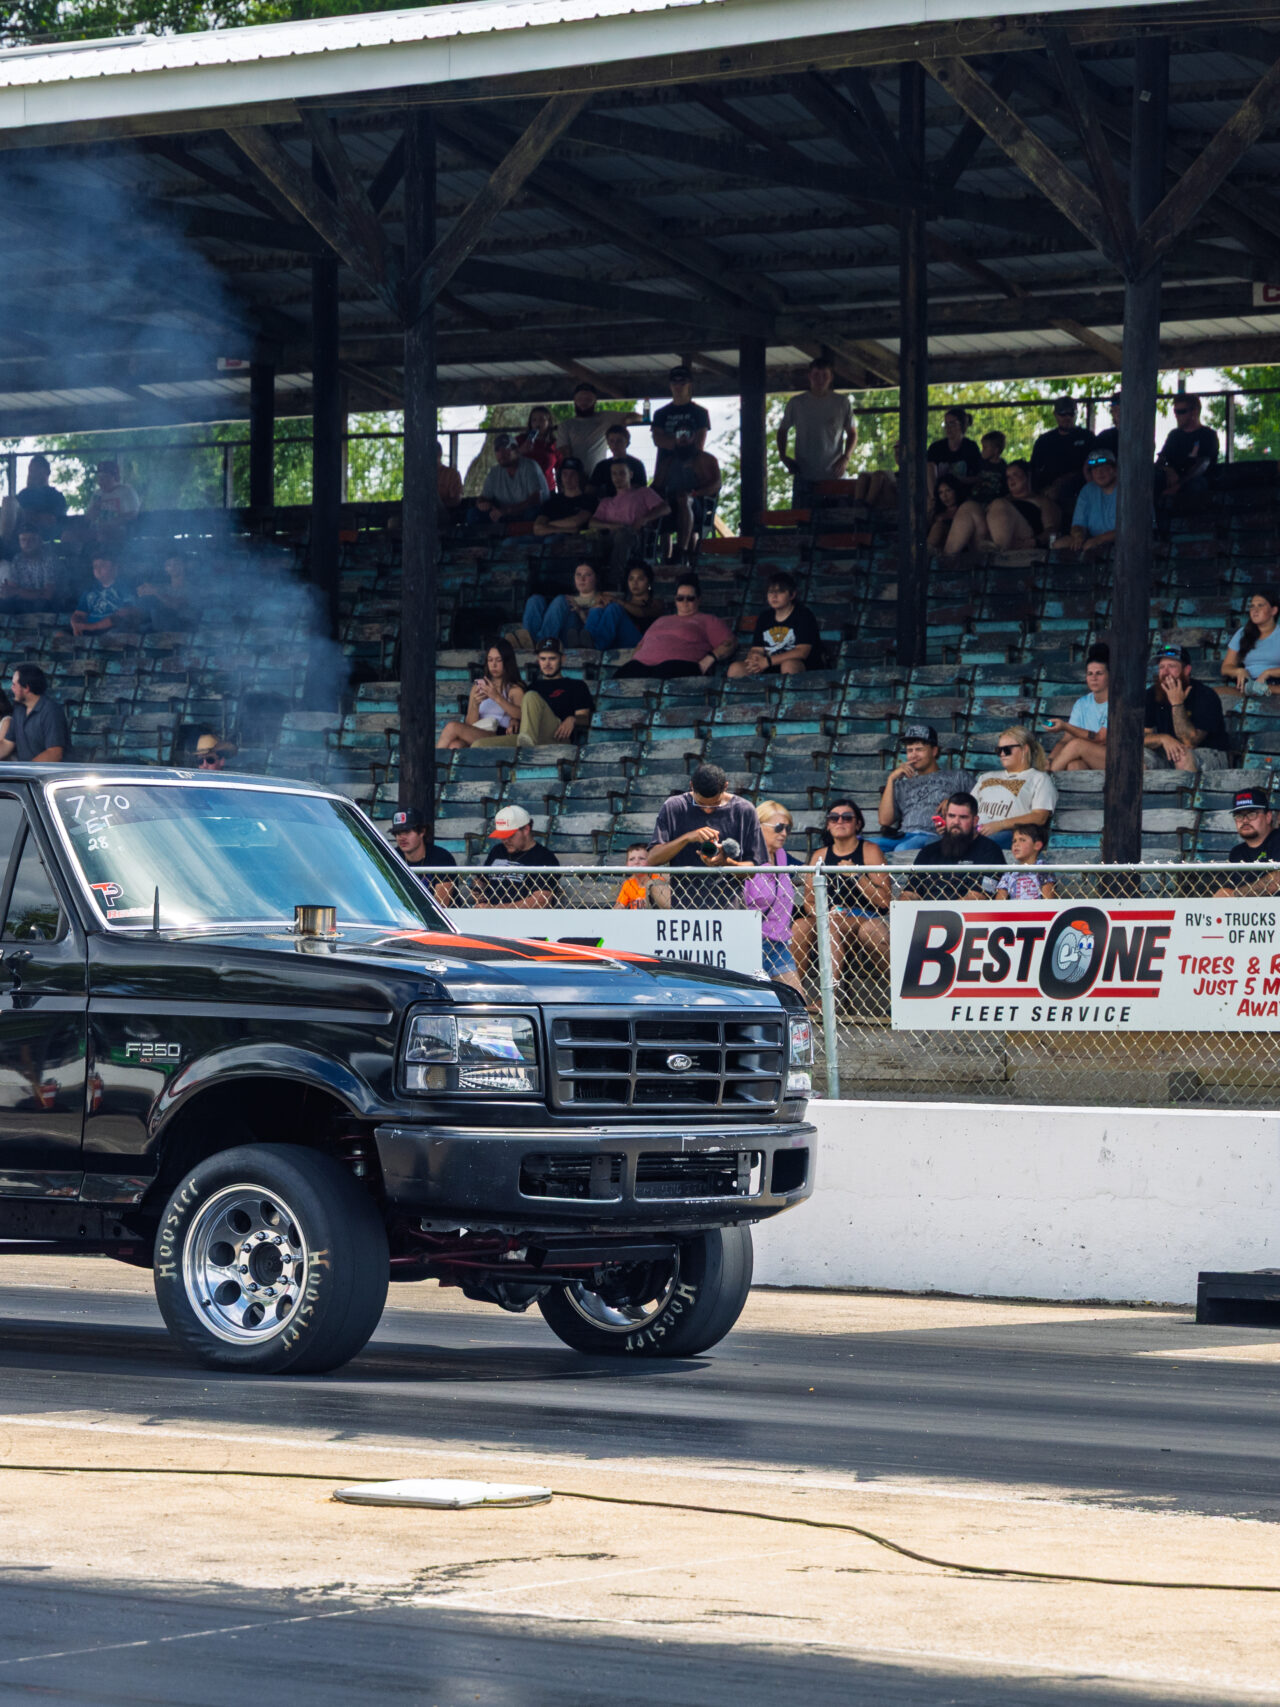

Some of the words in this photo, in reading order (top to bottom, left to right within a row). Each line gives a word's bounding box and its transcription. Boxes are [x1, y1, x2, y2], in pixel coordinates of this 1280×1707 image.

[66, 794, 130, 818] 7.70
[979, 797, 1013, 819] owgirl
[85, 813, 113, 834] ET
[87, 836, 109, 851] 28
[1185, 913, 1212, 926] RV's
[1225, 912, 1276, 926] TRUCKS
[656, 919, 723, 942] REPAIR
[1229, 930, 1245, 943] OF
[1249, 930, 1275, 943] ANY
[1178, 955, 1235, 975] TIRES
[1247, 956, 1260, 974] &
[1193, 977, 1238, 996] JUST
[1244, 977, 1256, 995] 5
[951, 1006, 1019, 1022] FLEET
[1031, 1006, 1132, 1022] SERVICE
[1237, 998, 1280, 1017] AWA
